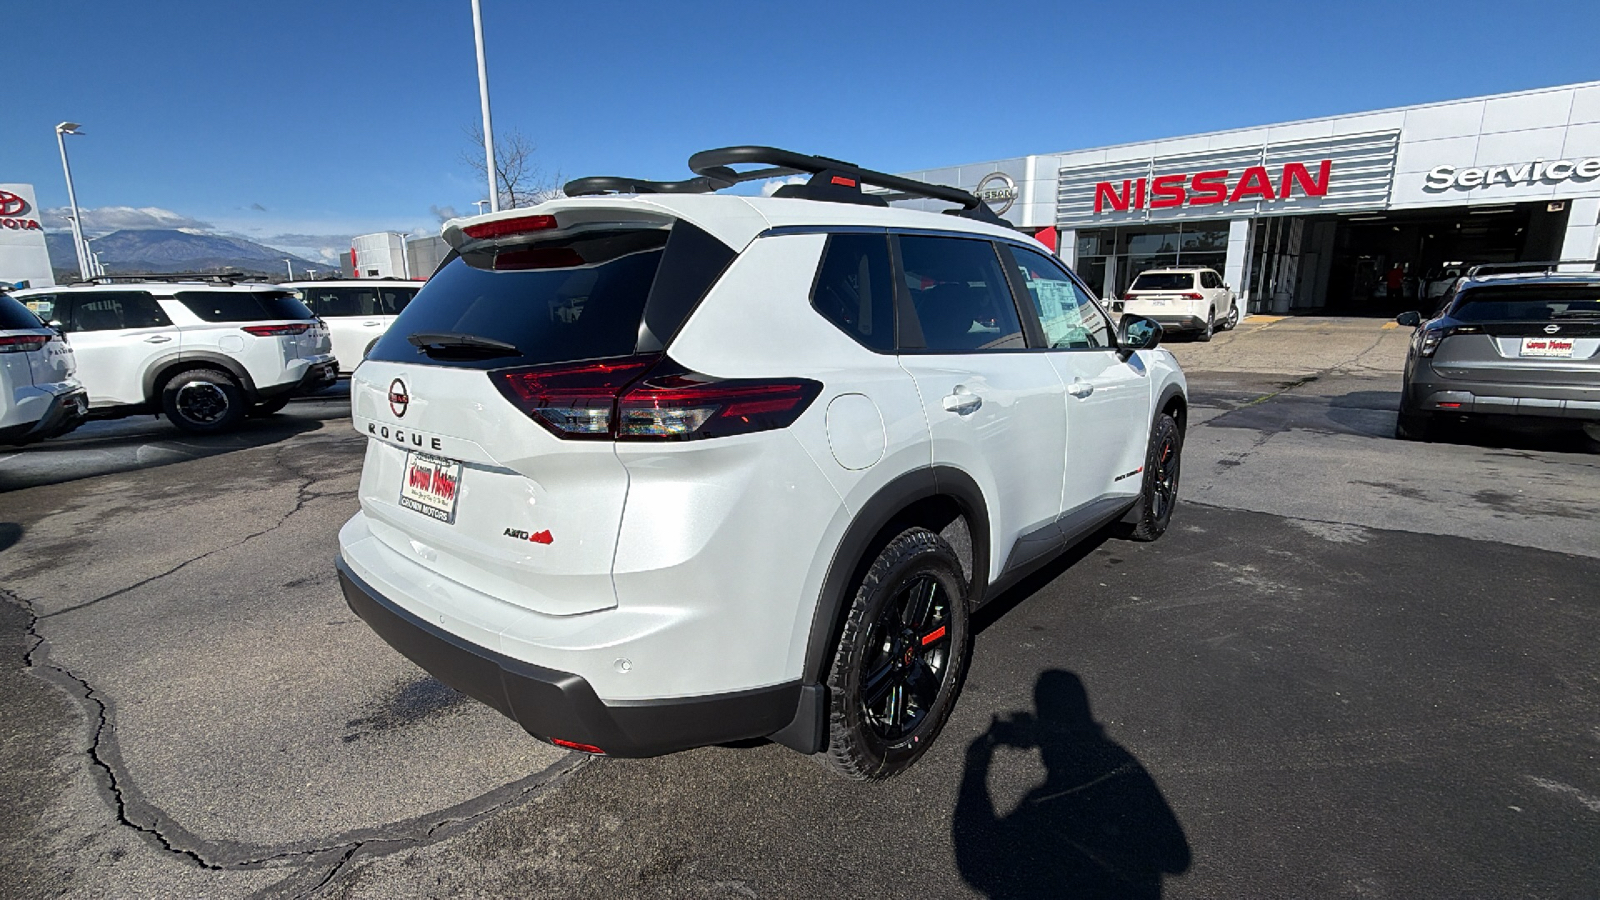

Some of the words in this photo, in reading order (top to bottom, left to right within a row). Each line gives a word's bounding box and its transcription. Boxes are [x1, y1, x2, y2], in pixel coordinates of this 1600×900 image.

[1094, 160, 1332, 213] NISSAN
[1425, 156, 1600, 190] Service
[368, 423, 442, 450] ROGUE
[401, 497, 422, 512] CROWN
[422, 503, 448, 521] MOTORS
[503, 527, 529, 541] AWD
